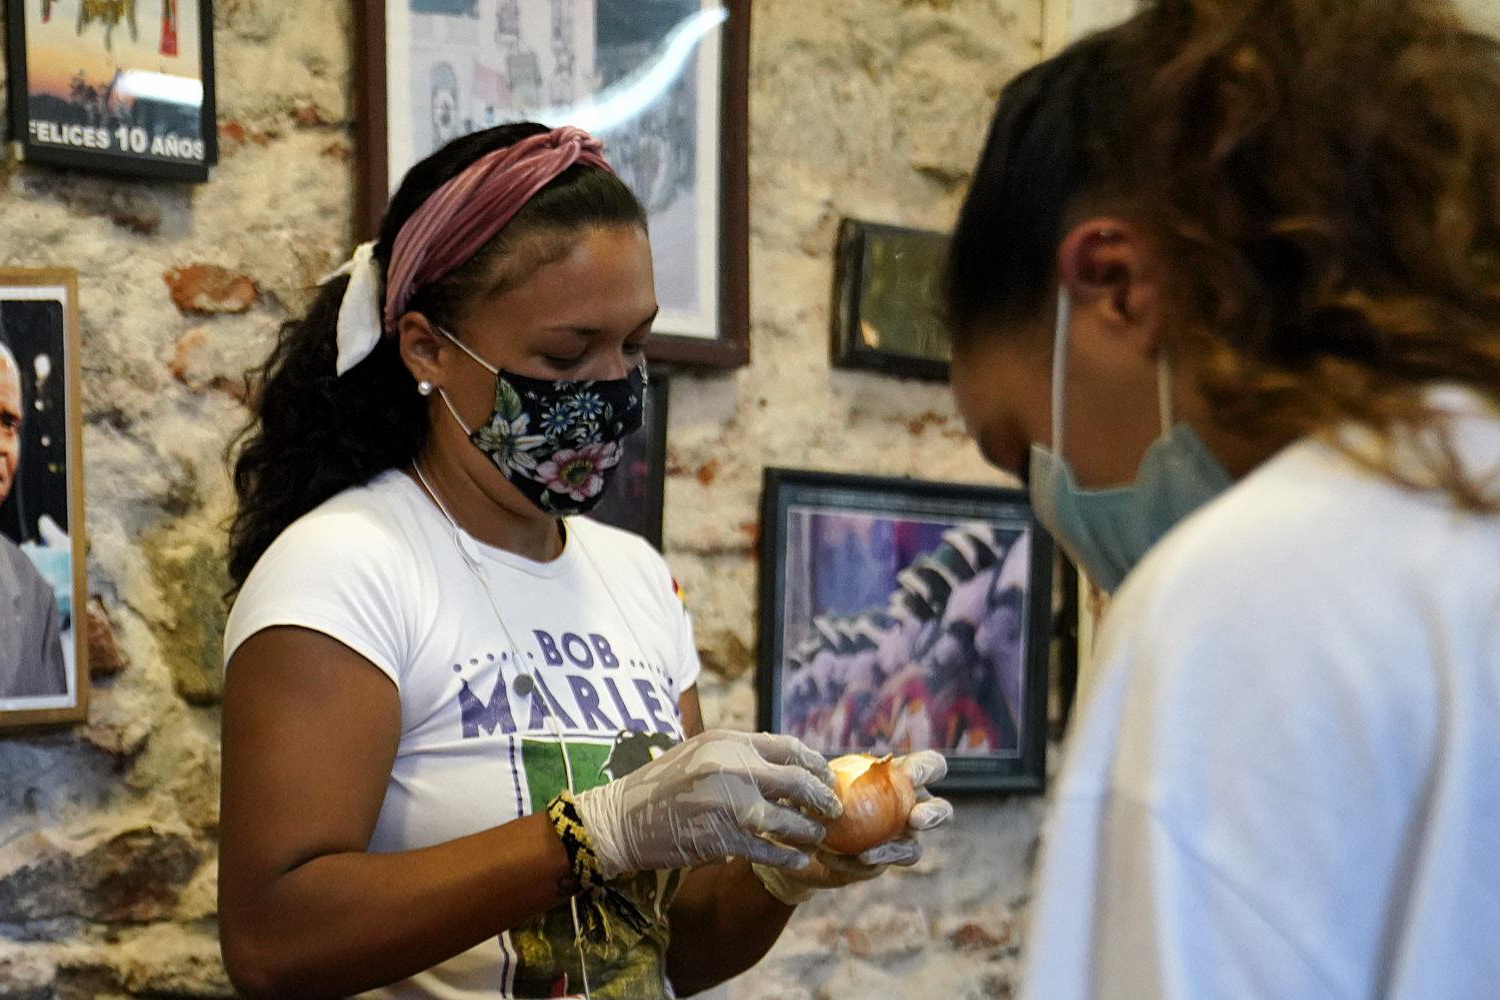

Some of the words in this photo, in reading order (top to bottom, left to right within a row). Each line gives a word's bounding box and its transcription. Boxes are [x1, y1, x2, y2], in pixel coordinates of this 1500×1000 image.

[115, 125, 148, 153] 10
[151, 134, 205, 160] AÑOS
[532, 629, 619, 670] BOB
[458, 665, 679, 738] MARLE
